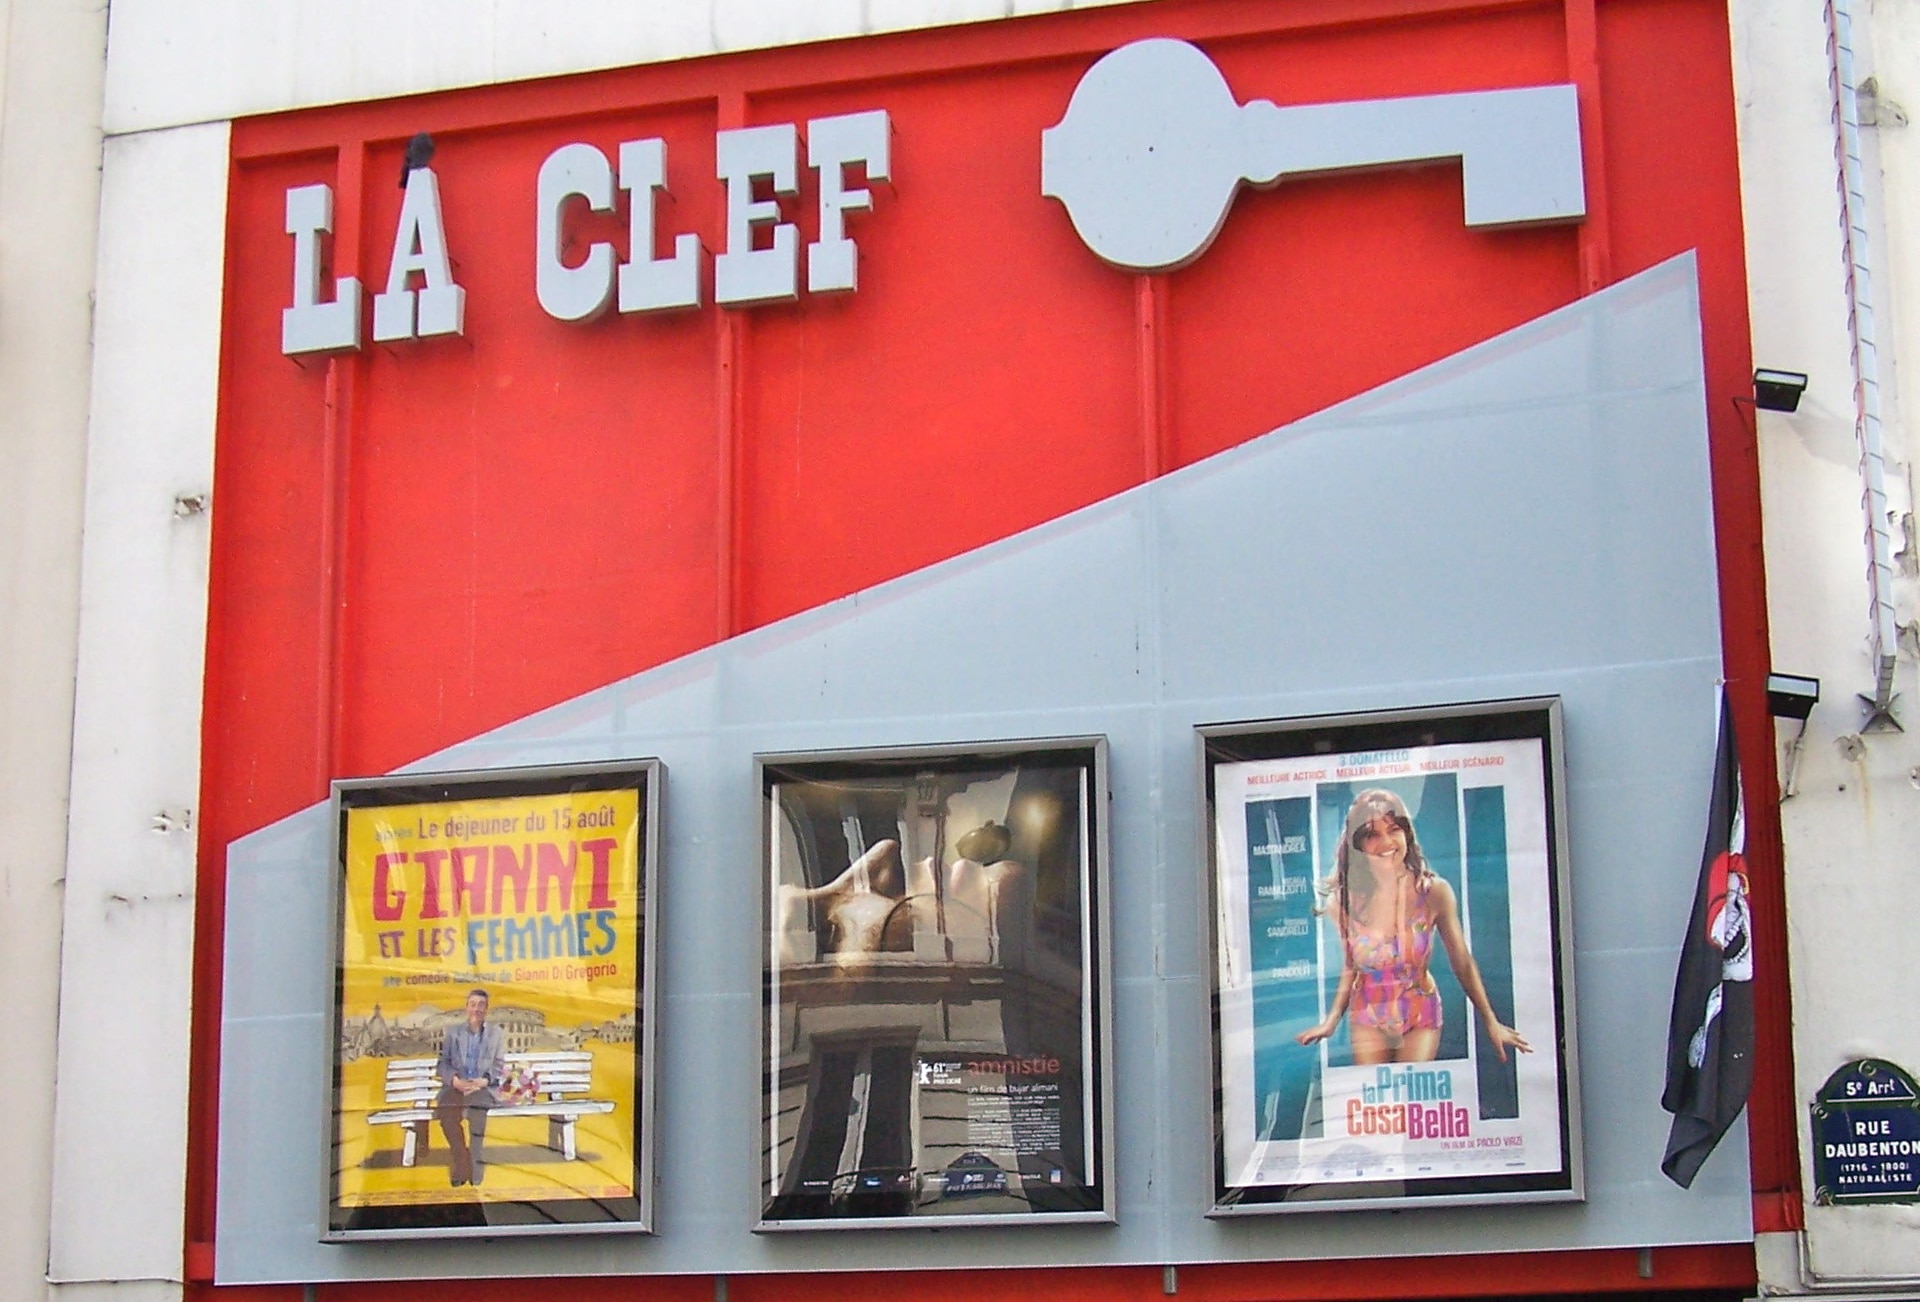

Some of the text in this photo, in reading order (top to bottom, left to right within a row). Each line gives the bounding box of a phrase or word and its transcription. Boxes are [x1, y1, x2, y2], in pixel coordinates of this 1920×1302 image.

[282, 109, 891, 356] LA CLEF
[1247, 773, 1289, 785] MEILLEURE
[1293, 770, 1326, 781] ACTRICE
[1337, 766, 1376, 778] MEILLEUR
[1379, 763, 1411, 775] ACTEUR
[1420, 759, 1460, 771] MEILLEUR
[418, 817, 439, 839] Le
[445, 814, 518, 841] déjeuner
[525, 810, 546, 833] du
[553, 807, 571, 830] 15
[577, 806, 616, 829] août
[373, 838, 617, 921] GIANNI
[378, 910, 617, 965] ET LES FEMMES
[515, 968, 549, 982] Gianni
[552, 967, 563, 980] Di
[566, 964, 617, 982] Gregorio
[968, 1055, 1060, 1076] amnistie
[1362, 1066, 1452, 1104] la Prima
[1346, 1099, 1470, 1140] Cosa Bella
[1856, 1121, 1890, 1135] RUE
[1477, 1137, 1501, 1147] PAOLO
[1825, 1141, 1920, 1158] DAUBENTON
[1839, 1173, 1912, 1184] NATURALISTE
